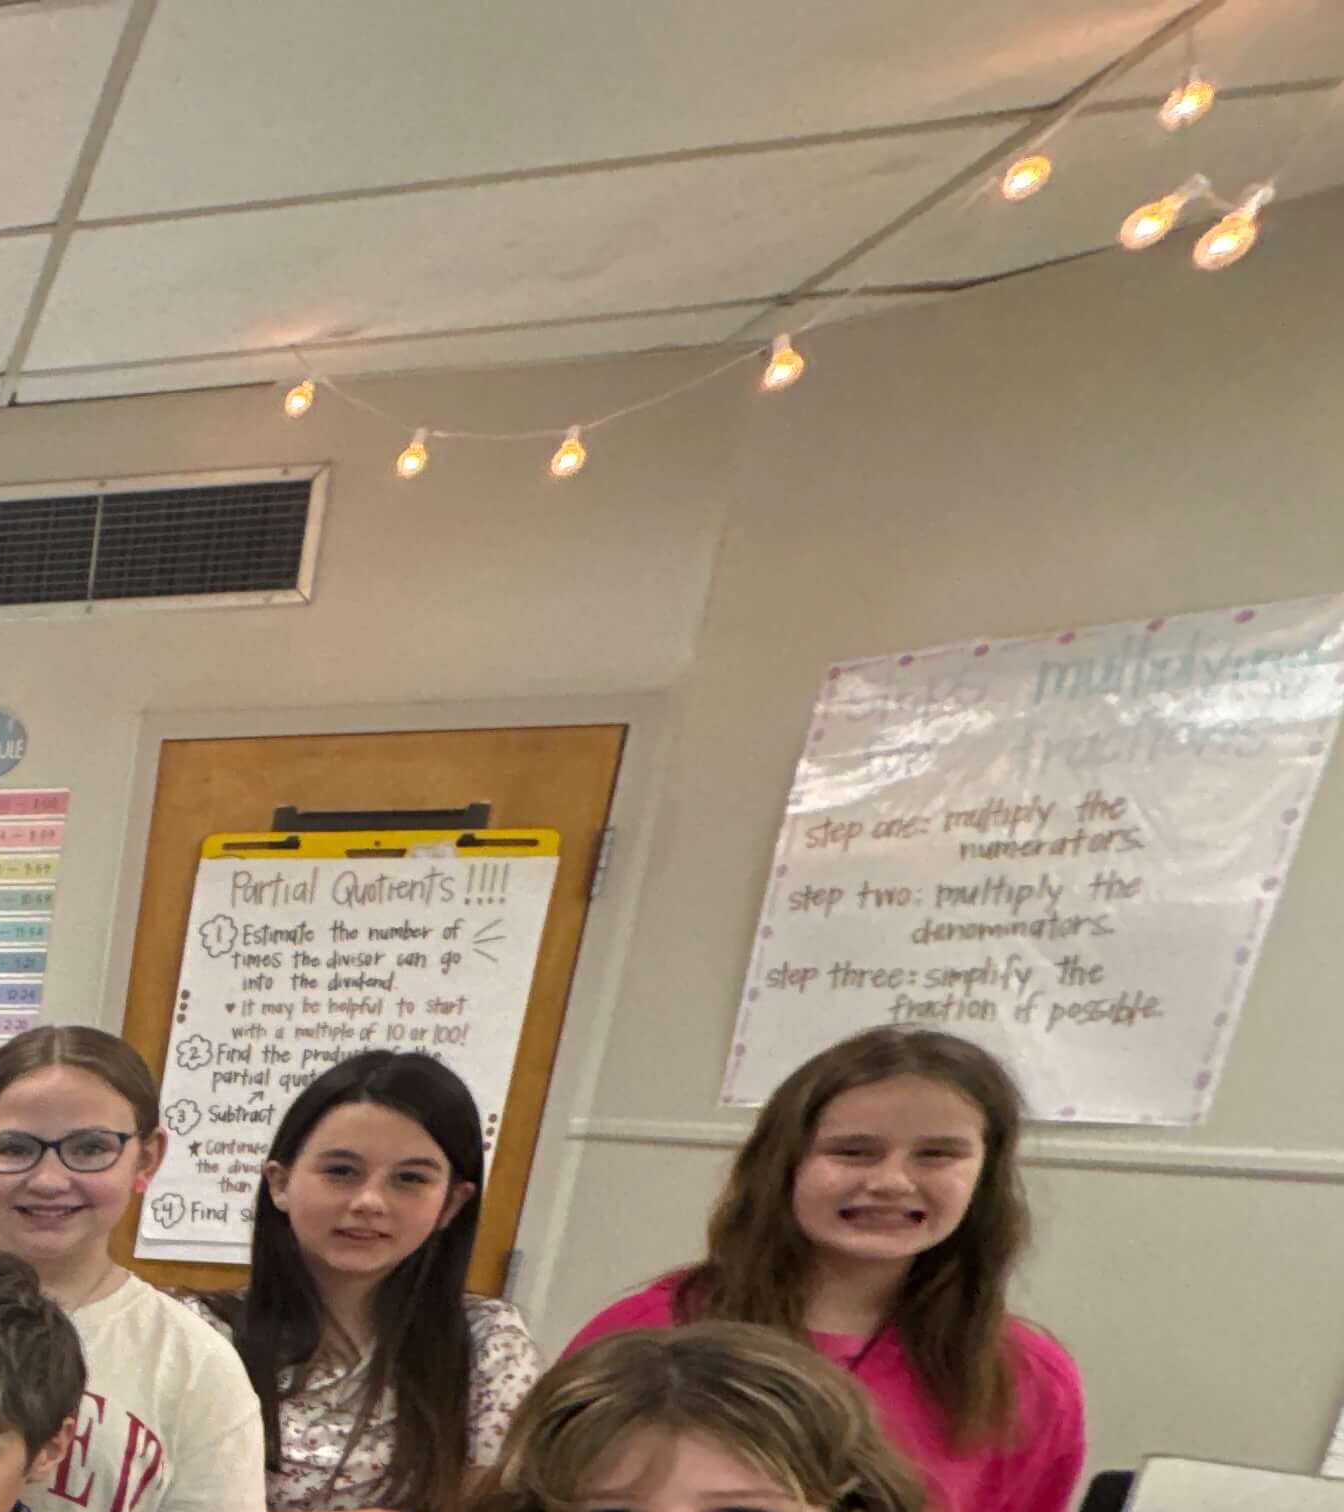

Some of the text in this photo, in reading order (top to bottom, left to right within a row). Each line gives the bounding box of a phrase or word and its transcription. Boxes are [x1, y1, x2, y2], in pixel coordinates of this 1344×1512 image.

[805, 817, 860, 852] step
[944, 795, 1055, 836] multiply
[1075, 790, 1126, 823] the
[231, 865, 319, 908] Partial
[331, 863, 456, 908] Quotients
[789, 884, 844, 918] step
[936, 873, 1063, 916] multiply
[1089, 870, 1143, 901] the
[242, 920, 315, 947] Estimate
[330, 919, 359, 942] the
[369, 920, 433, 940] number
[442, 918, 465, 940] of
[232, 951, 463, 976] times the divisor can go
[766, 962, 818, 993] step
[923, 955, 1032, 995] simplify
[1055, 955, 1105, 986] the
[242, 973, 274, 991] into
[290, 972, 318, 990] the
[261, 1002, 294, 1021] may
[302, 999, 321, 1014] be
[328, 999, 383, 1020] helpful
[396, 998, 415, 1016] to
[426, 996, 469, 1016] start
[889, 997, 996, 1024] fraction
[232, 1023, 267, 1040] with
[295, 1023, 354, 1042] multiple
[360, 1023, 377, 1041] of
[386, 1023, 405, 1041] 10
[189, 1043, 291, 1066] 2 Find the
[212, 1068, 271, 1092] partial
[178, 1103, 275, 1126] 3 Subtract
[196, 1159, 219, 1175] the
[218, 1175, 252, 1193] than
[162, 1202, 173, 1221] 4
[191, 1200, 229, 1223] Find
